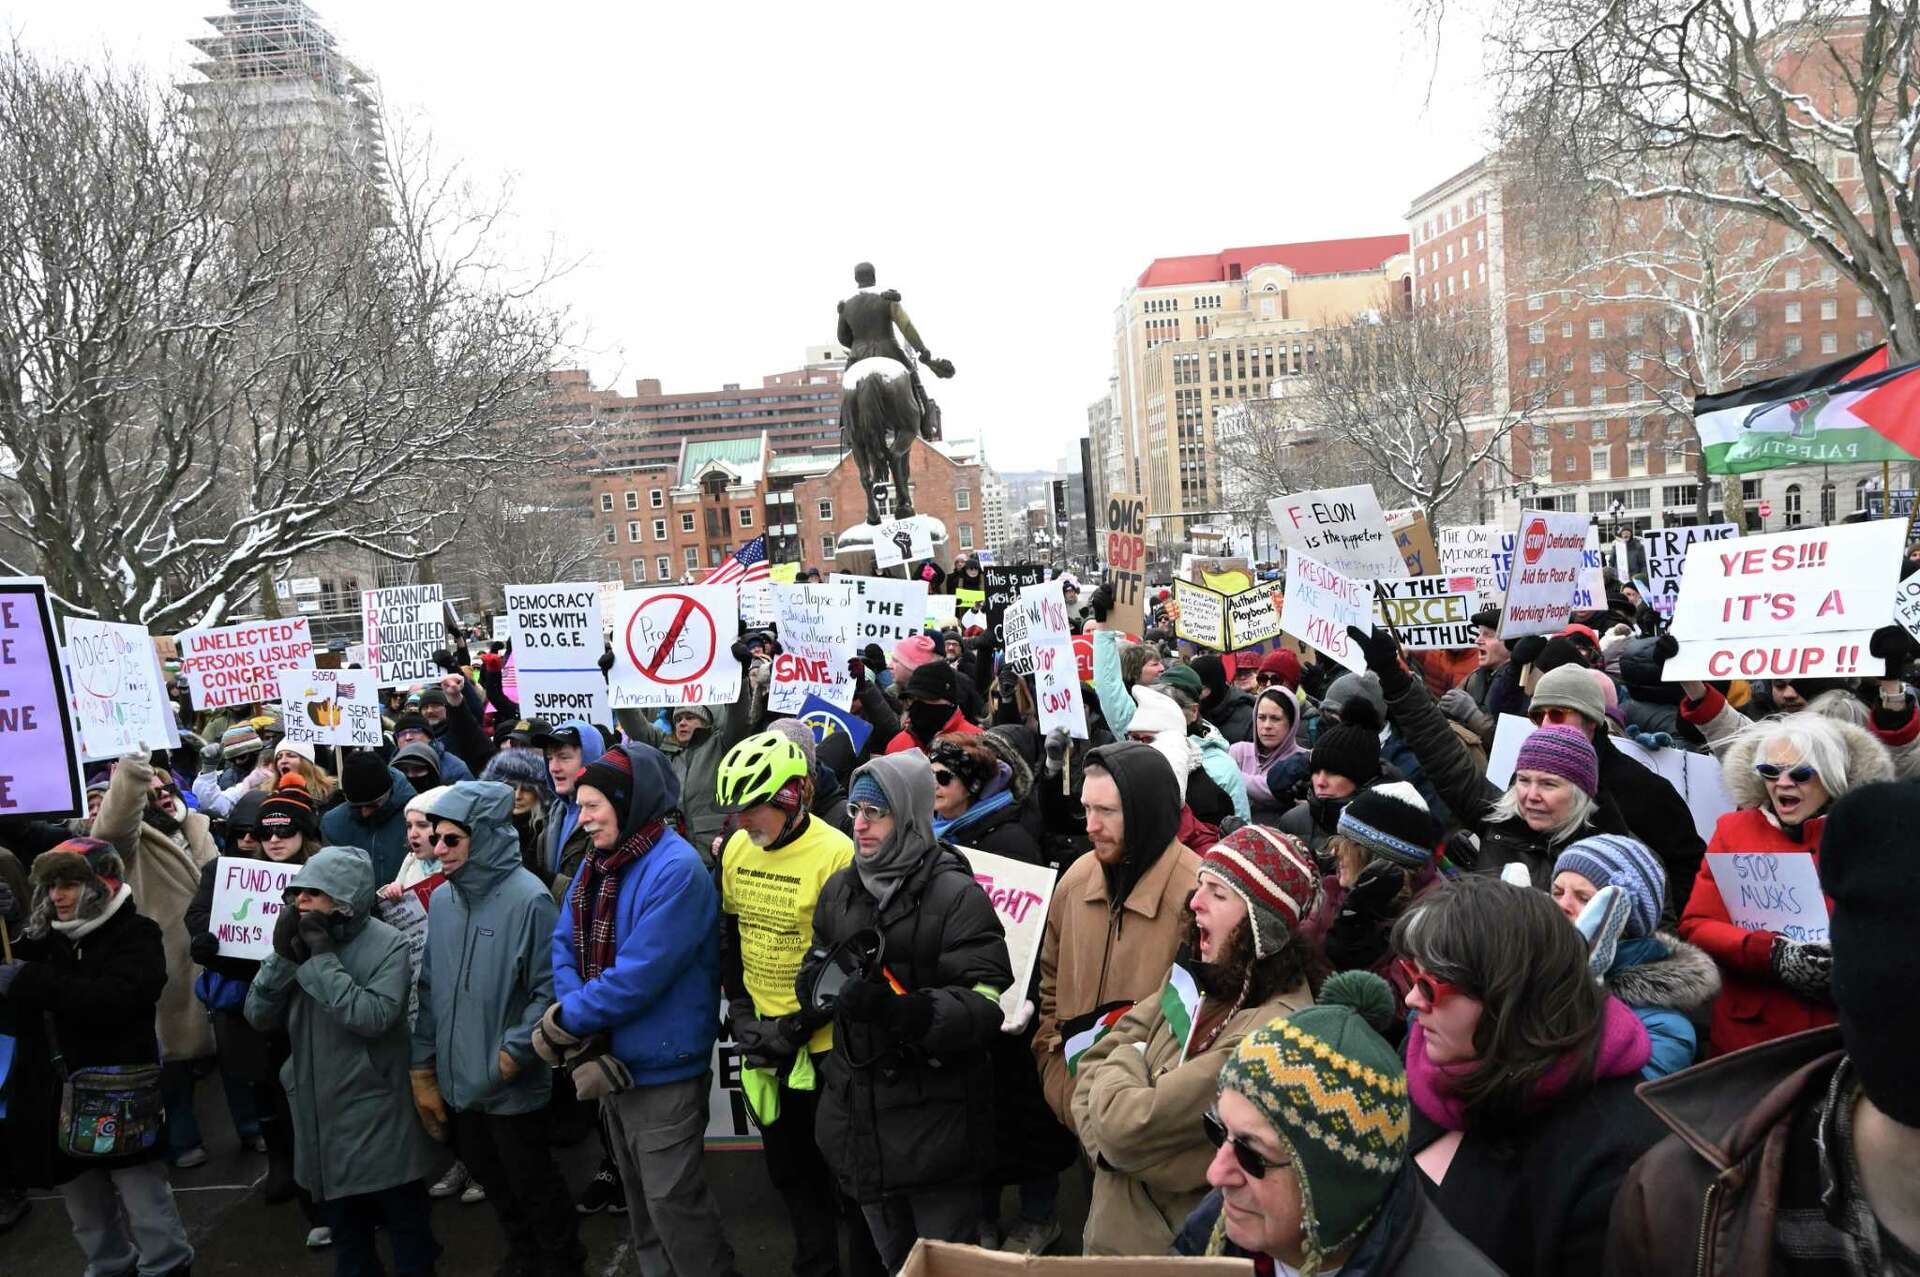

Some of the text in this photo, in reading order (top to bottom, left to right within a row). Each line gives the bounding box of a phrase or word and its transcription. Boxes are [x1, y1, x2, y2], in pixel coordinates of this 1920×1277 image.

[1108, 498, 1144, 535] OMG
[1304, 536, 1320, 549] is
[1322, 529, 1340, 544] the
[1547, 533, 1586, 552] Defunding
[1108, 533, 1144, 572] GOP
[1720, 541, 1828, 577] YES!!!
[986, 569, 1038, 586] this is not
[1297, 557, 1360, 608] PRESIDENTS
[1520, 568, 1535, 584] Aid
[1537, 569, 1549, 584] for
[1549, 568, 1568, 582] Poor
[365, 585, 442, 608] TYRANNICAL
[841, 580, 866, 594] E
[1405, 578, 1449, 597] THE
[510, 593, 595, 611] DEMOCRACY
[866, 600, 904, 616] THE
[1232, 602, 1274, 623] Playbook
[1509, 604, 1545, 623] Working
[1545, 602, 1571, 620] People
[1722, 589, 1846, 622] IT'S A
[368, 605, 420, 627] RACIST
[519, 614, 547, 628] DIES
[548, 613, 587, 628] WITH
[190, 625, 293, 653] UNELECTED
[368, 622, 444, 646] UNQUALIFIED
[1306, 615, 1349, 657] KINGS
[1396, 623, 1481, 645] WITH US
[187, 642, 312, 672] PERSONS USURP
[1708, 645, 1859, 677] COUP !!
[775, 654, 832, 684] SAVE
[204, 683, 280, 708] AUTHORI
[534, 693, 593, 708] SUPPORT
[681, 684, 703, 703] NO
[1042, 689, 1072, 713] COUP
[287, 700, 302, 713] WE
[347, 704, 378, 719] SERVE
[286, 714, 304, 728] THE
[352, 718, 366, 730] NO
[287, 729, 324, 743] PEOPLE
[352, 730, 379, 744] KING
[1733, 853, 1779, 882] STOP
[227, 866, 271, 893] FUND
[1741, 884, 1802, 914] MUSK'S
[217, 924, 262, 944] MUSK'S
